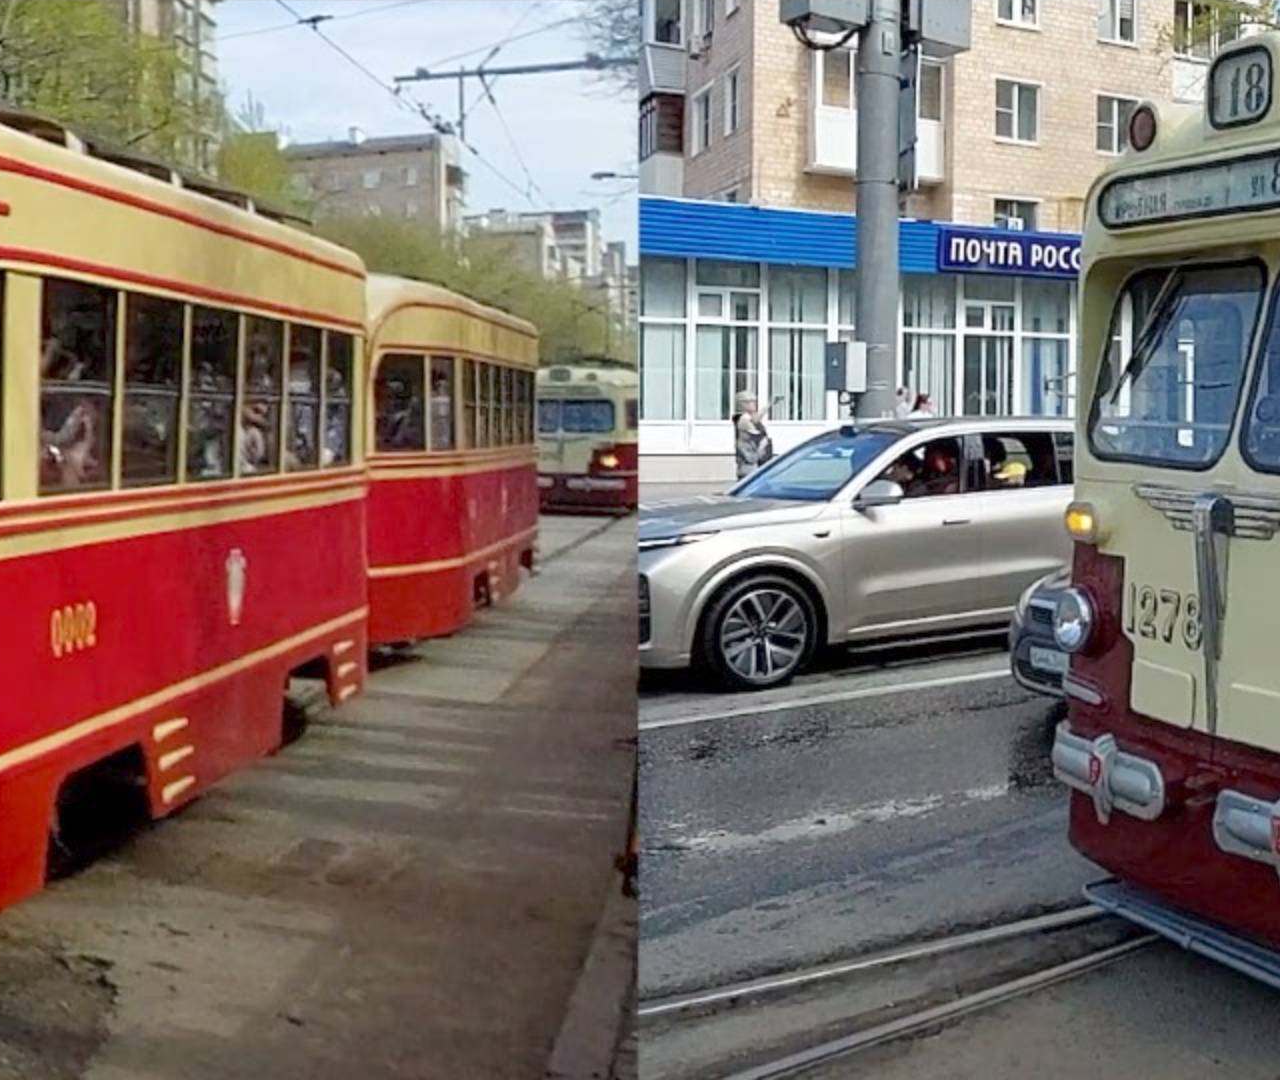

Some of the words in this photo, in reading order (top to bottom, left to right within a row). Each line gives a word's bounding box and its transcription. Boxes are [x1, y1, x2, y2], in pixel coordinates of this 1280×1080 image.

[1227, 62, 1265, 118] 18
[950, 237, 1023, 267] ПОЧТА
[1126, 582, 1202, 651] 1278
